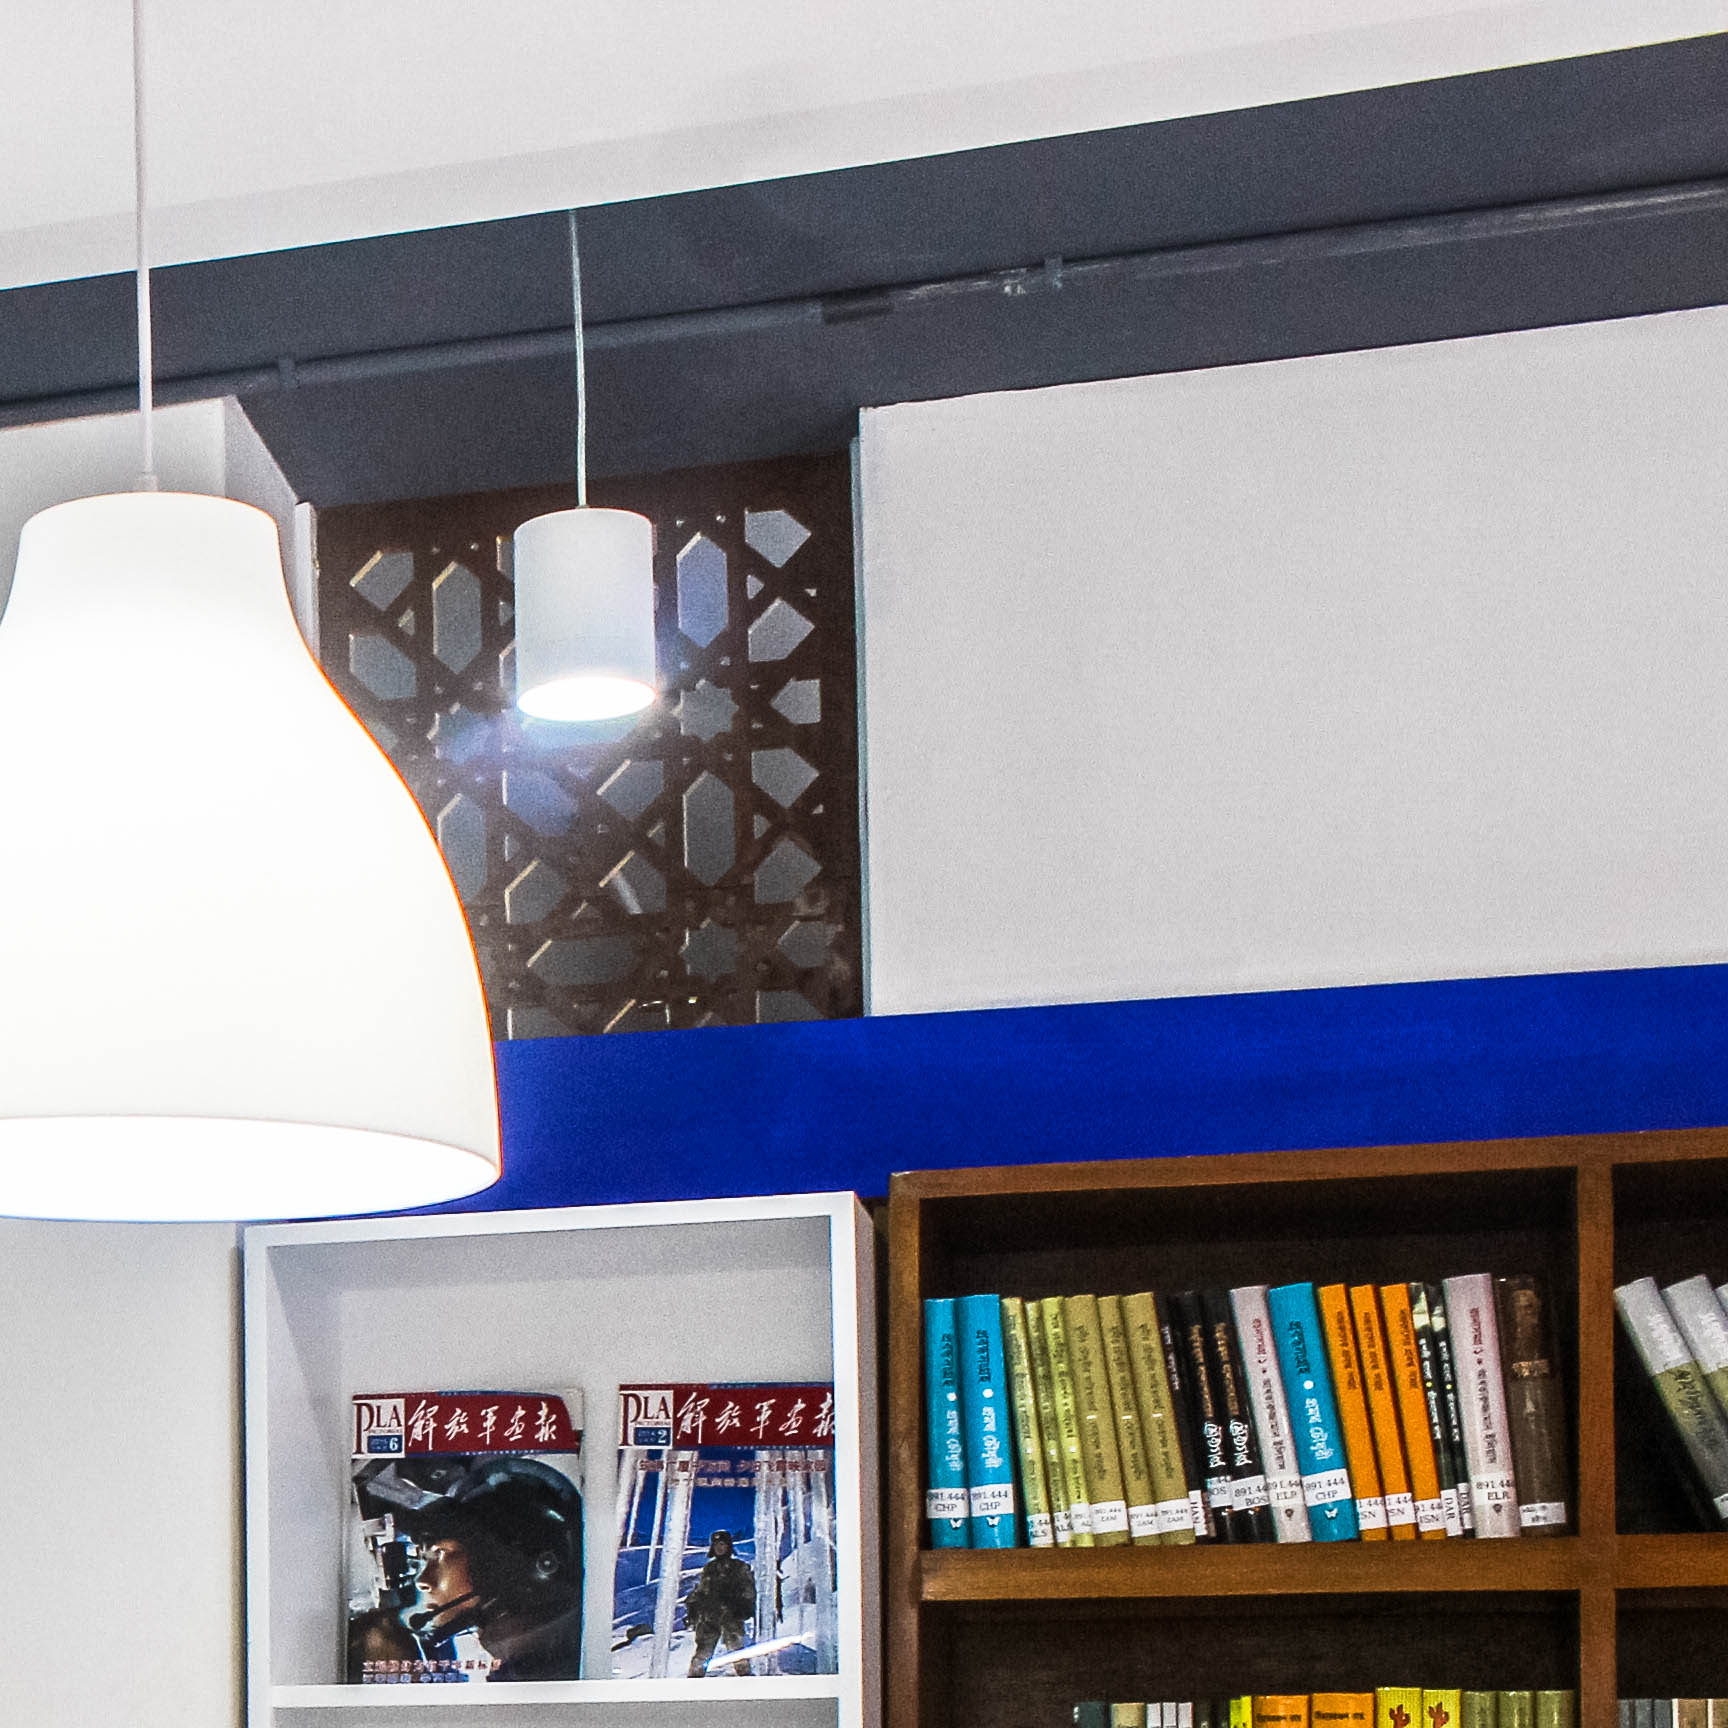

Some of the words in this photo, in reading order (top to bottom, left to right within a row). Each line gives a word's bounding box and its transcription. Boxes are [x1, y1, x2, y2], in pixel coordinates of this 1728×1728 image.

[353, 1402, 403, 1455] PLA
[619, 1393, 671, 1446] PLA
[389, 1438, 398, 1450] 6
[657, 1430, 666, 1443] 2
